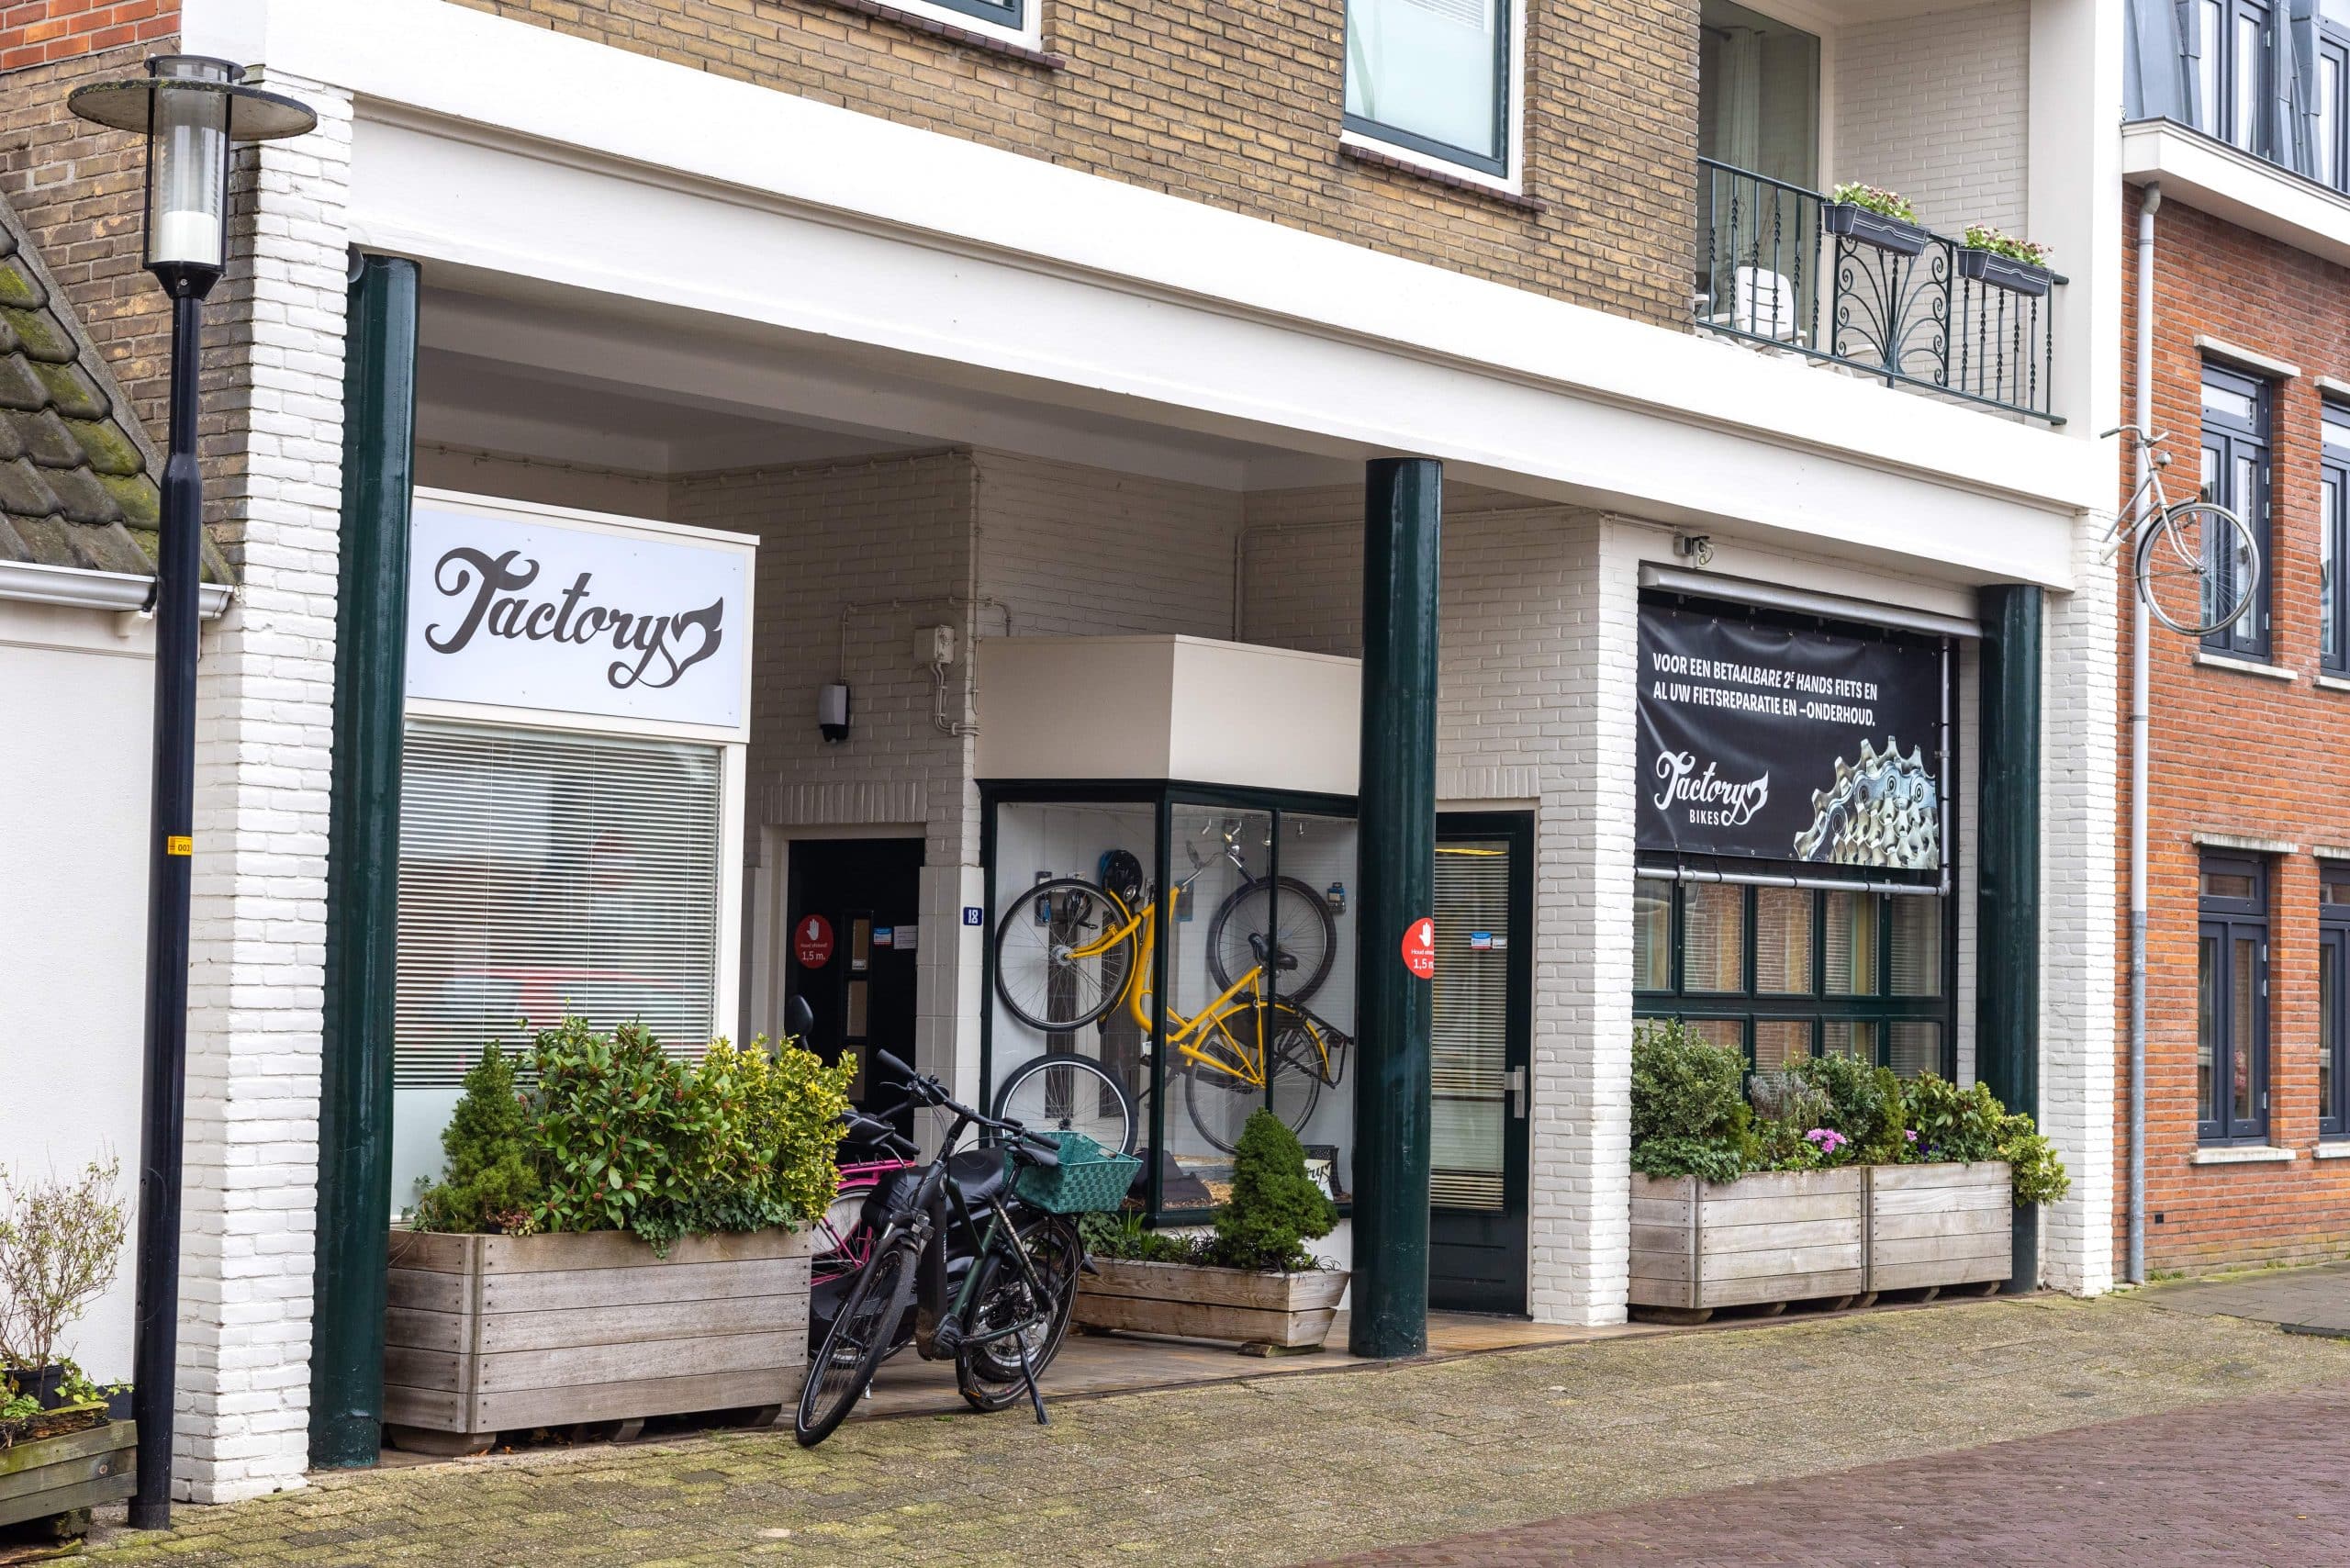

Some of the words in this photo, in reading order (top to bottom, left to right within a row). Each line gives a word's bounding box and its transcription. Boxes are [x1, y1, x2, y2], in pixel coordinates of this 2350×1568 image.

[1652, 652, 1688, 676] VOOR
[1690, 657, 1711, 678] EEN
[1713, 660, 1783, 688] BETAALBARE
[1796, 673, 1833, 695] HANDS
[1835, 678, 1863, 699] FIETS
[1863, 682, 1878, 701] EN
[1653, 680, 1668, 700] AL
[1670, 682, 1691, 703] UW
[1693, 686, 1781, 715] FIETSREPARATIE
[1783, 698, 1797, 717] EN
[1689, 809, 1719, 825] BIKES
[968, 909, 979, 924] 18
[801, 950, 814, 962] 1,5
[1413, 958, 1427, 969] 1,5
